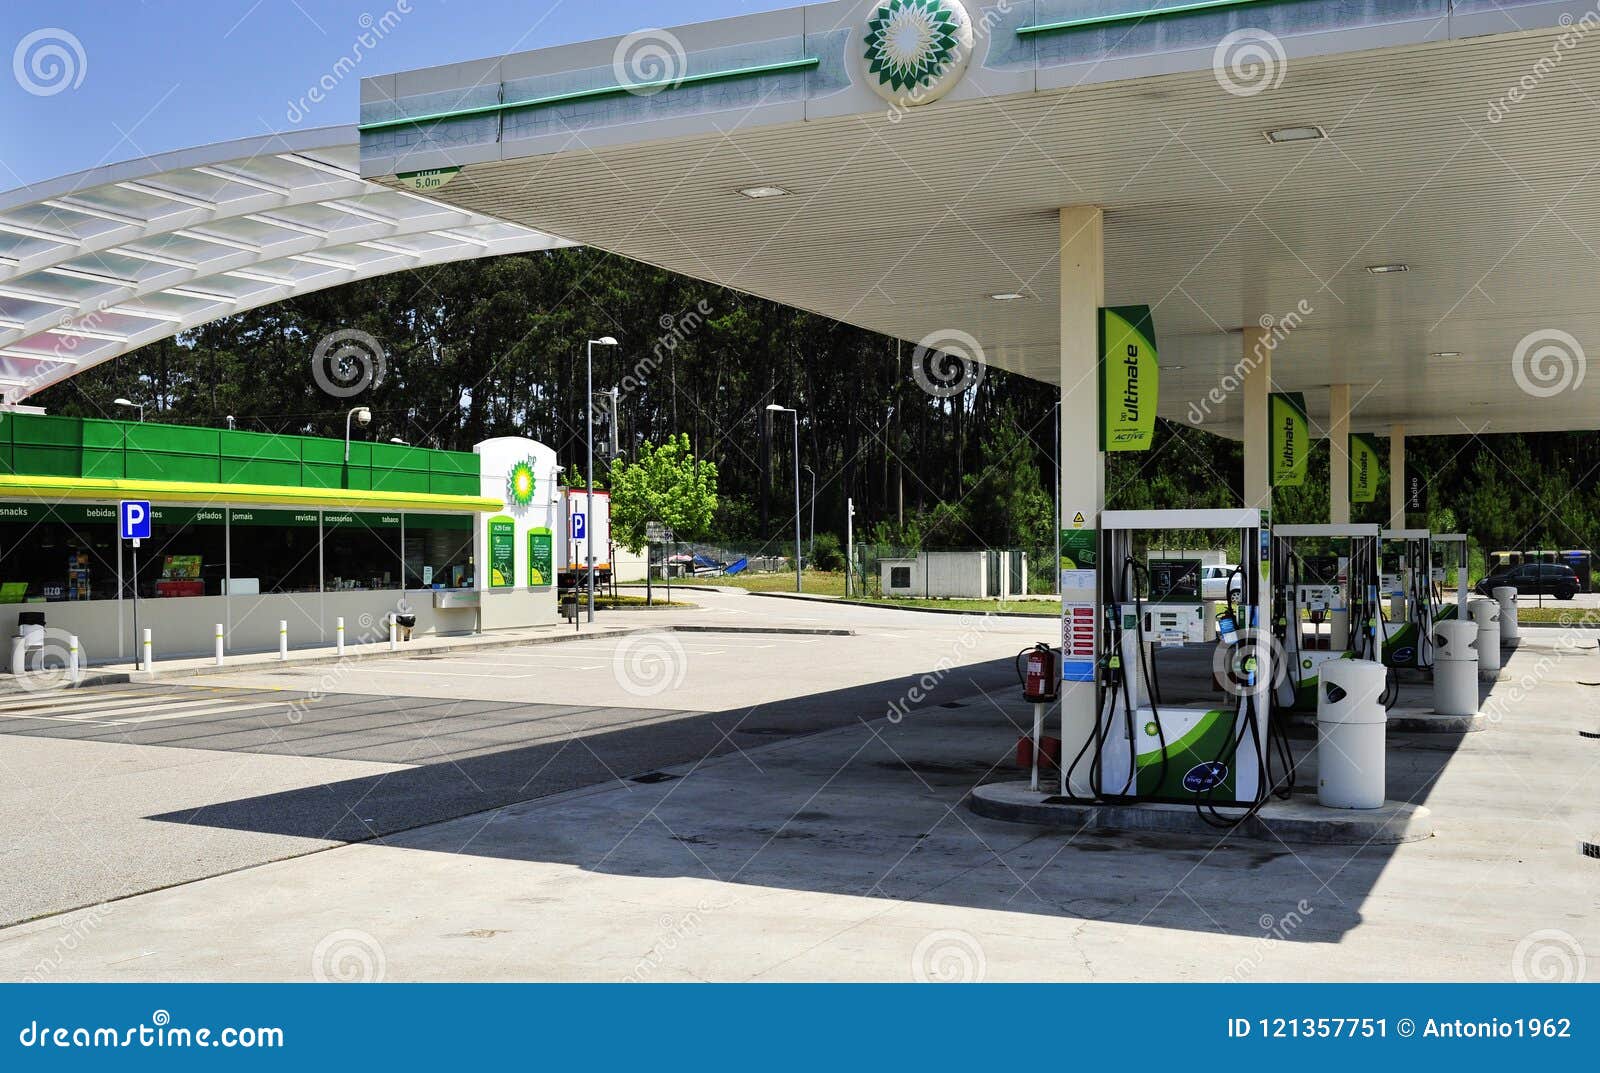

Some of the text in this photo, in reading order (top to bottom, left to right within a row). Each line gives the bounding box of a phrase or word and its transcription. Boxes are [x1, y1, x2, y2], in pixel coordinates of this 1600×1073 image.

[1124, 344, 1138, 421] ultimate
[1284, 417, 1294, 467] ultimate
[0, 507, 28, 516] snacks
[86, 508, 116, 517] bebidas
[196, 511, 222, 520] gelados
[295, 513, 317, 521] revistas
[127, 504, 145, 536] P
[574, 515, 583, 537] P
[1332, 586, 1340, 595] 3
[1195, 606, 1203, 620] 1
